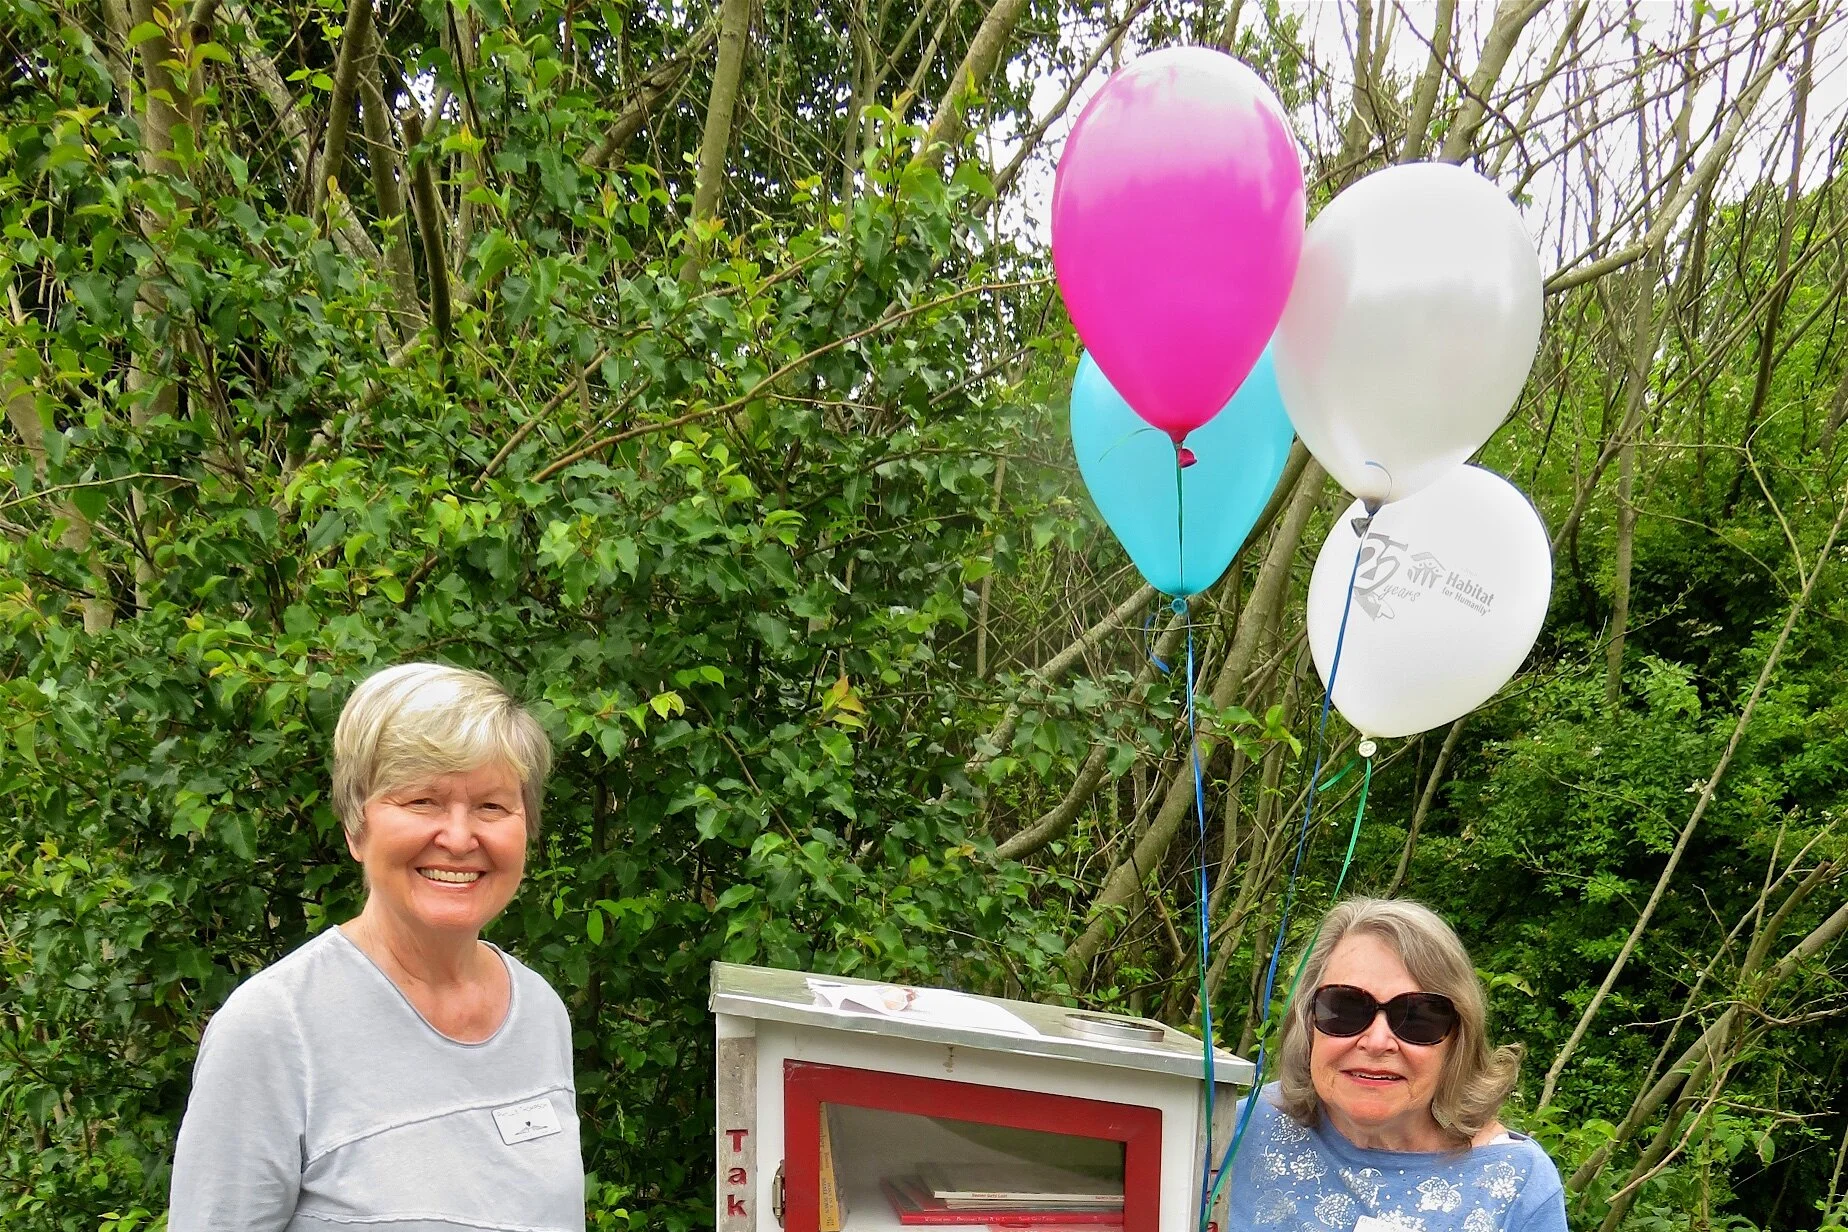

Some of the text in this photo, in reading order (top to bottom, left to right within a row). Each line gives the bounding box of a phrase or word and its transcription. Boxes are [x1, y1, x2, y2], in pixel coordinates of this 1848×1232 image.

[1378, 584, 1421, 602] years
[1442, 586, 1488, 617] for Humanity
[1446, 571, 1495, 607] Habitat
